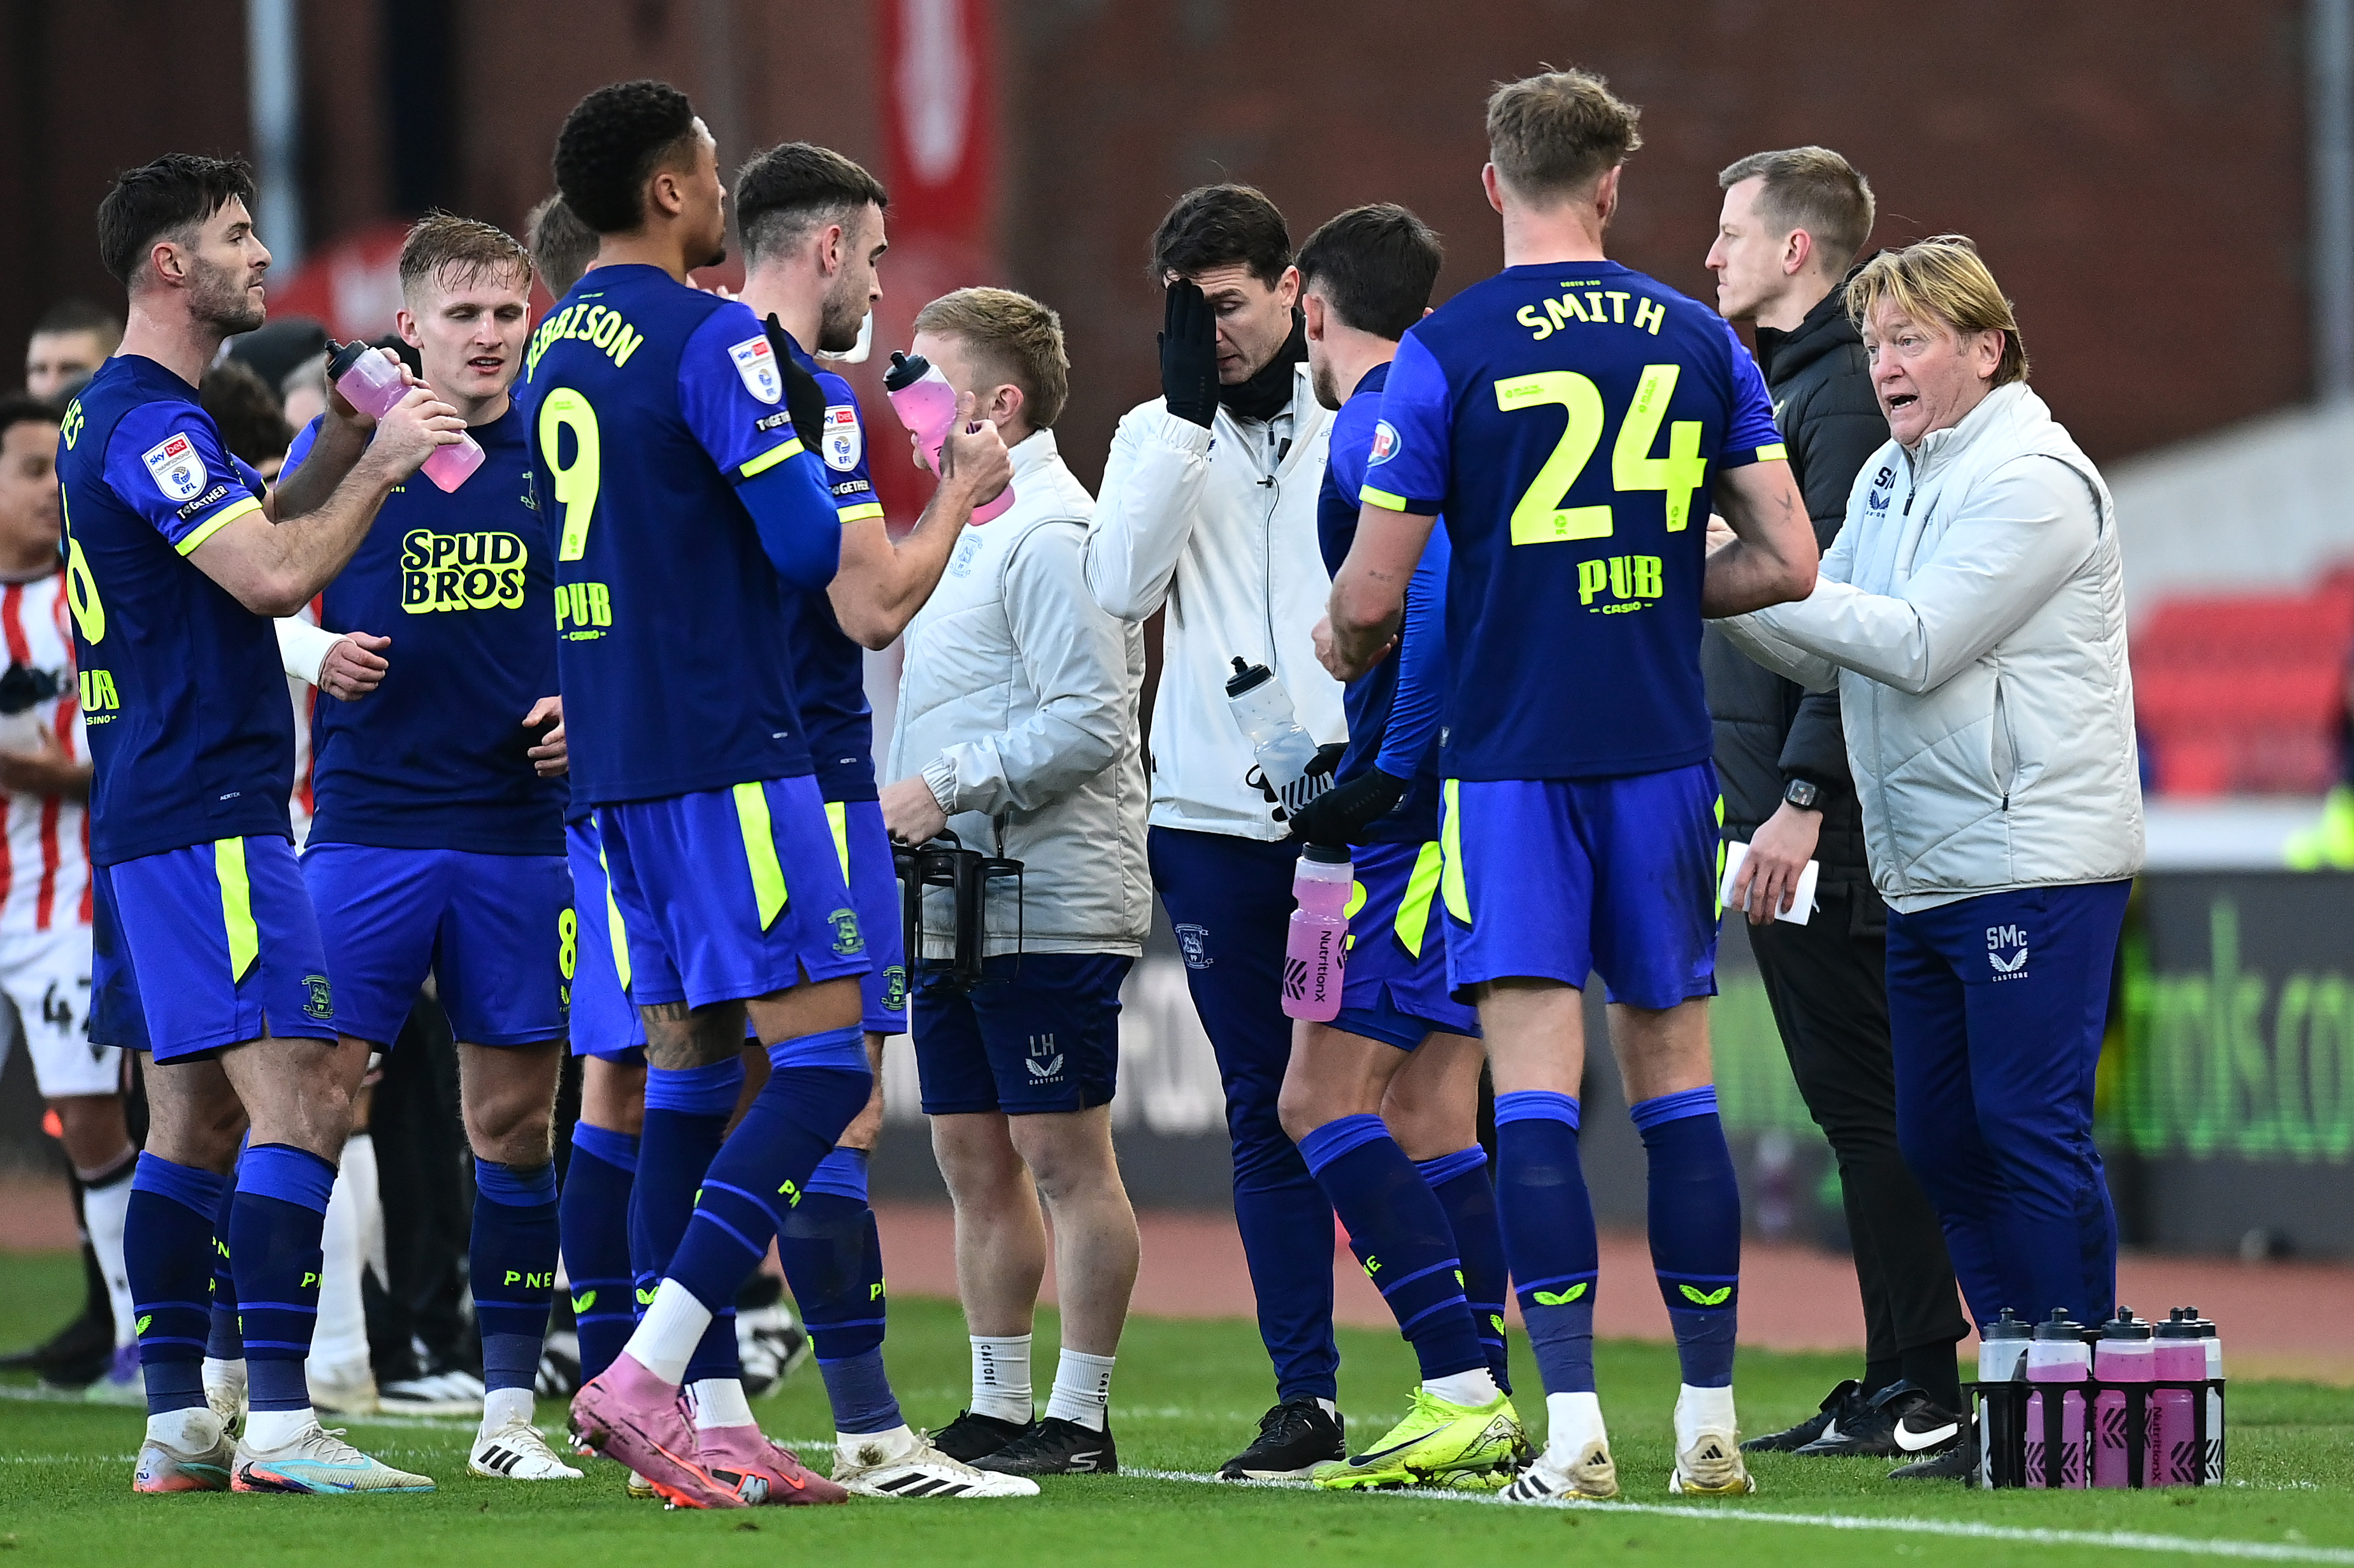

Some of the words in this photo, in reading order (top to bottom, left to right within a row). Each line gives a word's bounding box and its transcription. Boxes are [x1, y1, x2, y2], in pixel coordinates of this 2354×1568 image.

[1516, 291, 1665, 340] SMITH
[526, 304, 643, 384] JEBBISON
[838, 413, 852, 422] bet
[150, 452, 165, 466] sky
[166, 440, 186, 454] bet
[540, 387, 599, 561] 9
[838, 456, 852, 464] EFL
[1494, 364, 1708, 545] 24
[176, 485, 228, 519] TOGETHER
[180, 483, 197, 494] EFL
[401, 529, 527, 571] SPUD
[401, 567, 525, 613] BROS
[1576, 555, 1663, 605] PUB
[554, 583, 612, 631] PUB
[79, 669, 120, 711] UB
[558, 908, 577, 980] 8
[1986, 924, 2027, 950] SMc
[1314, 930, 1332, 1002] NutritionX
[1992, 971, 2028, 981] CASTORE
[1029, 1032, 1055, 1057] LH
[1029, 1075, 1064, 1085] CASTORE
[504, 1270, 552, 1288] PNE
[980, 1344, 996, 1386] CASTORE
